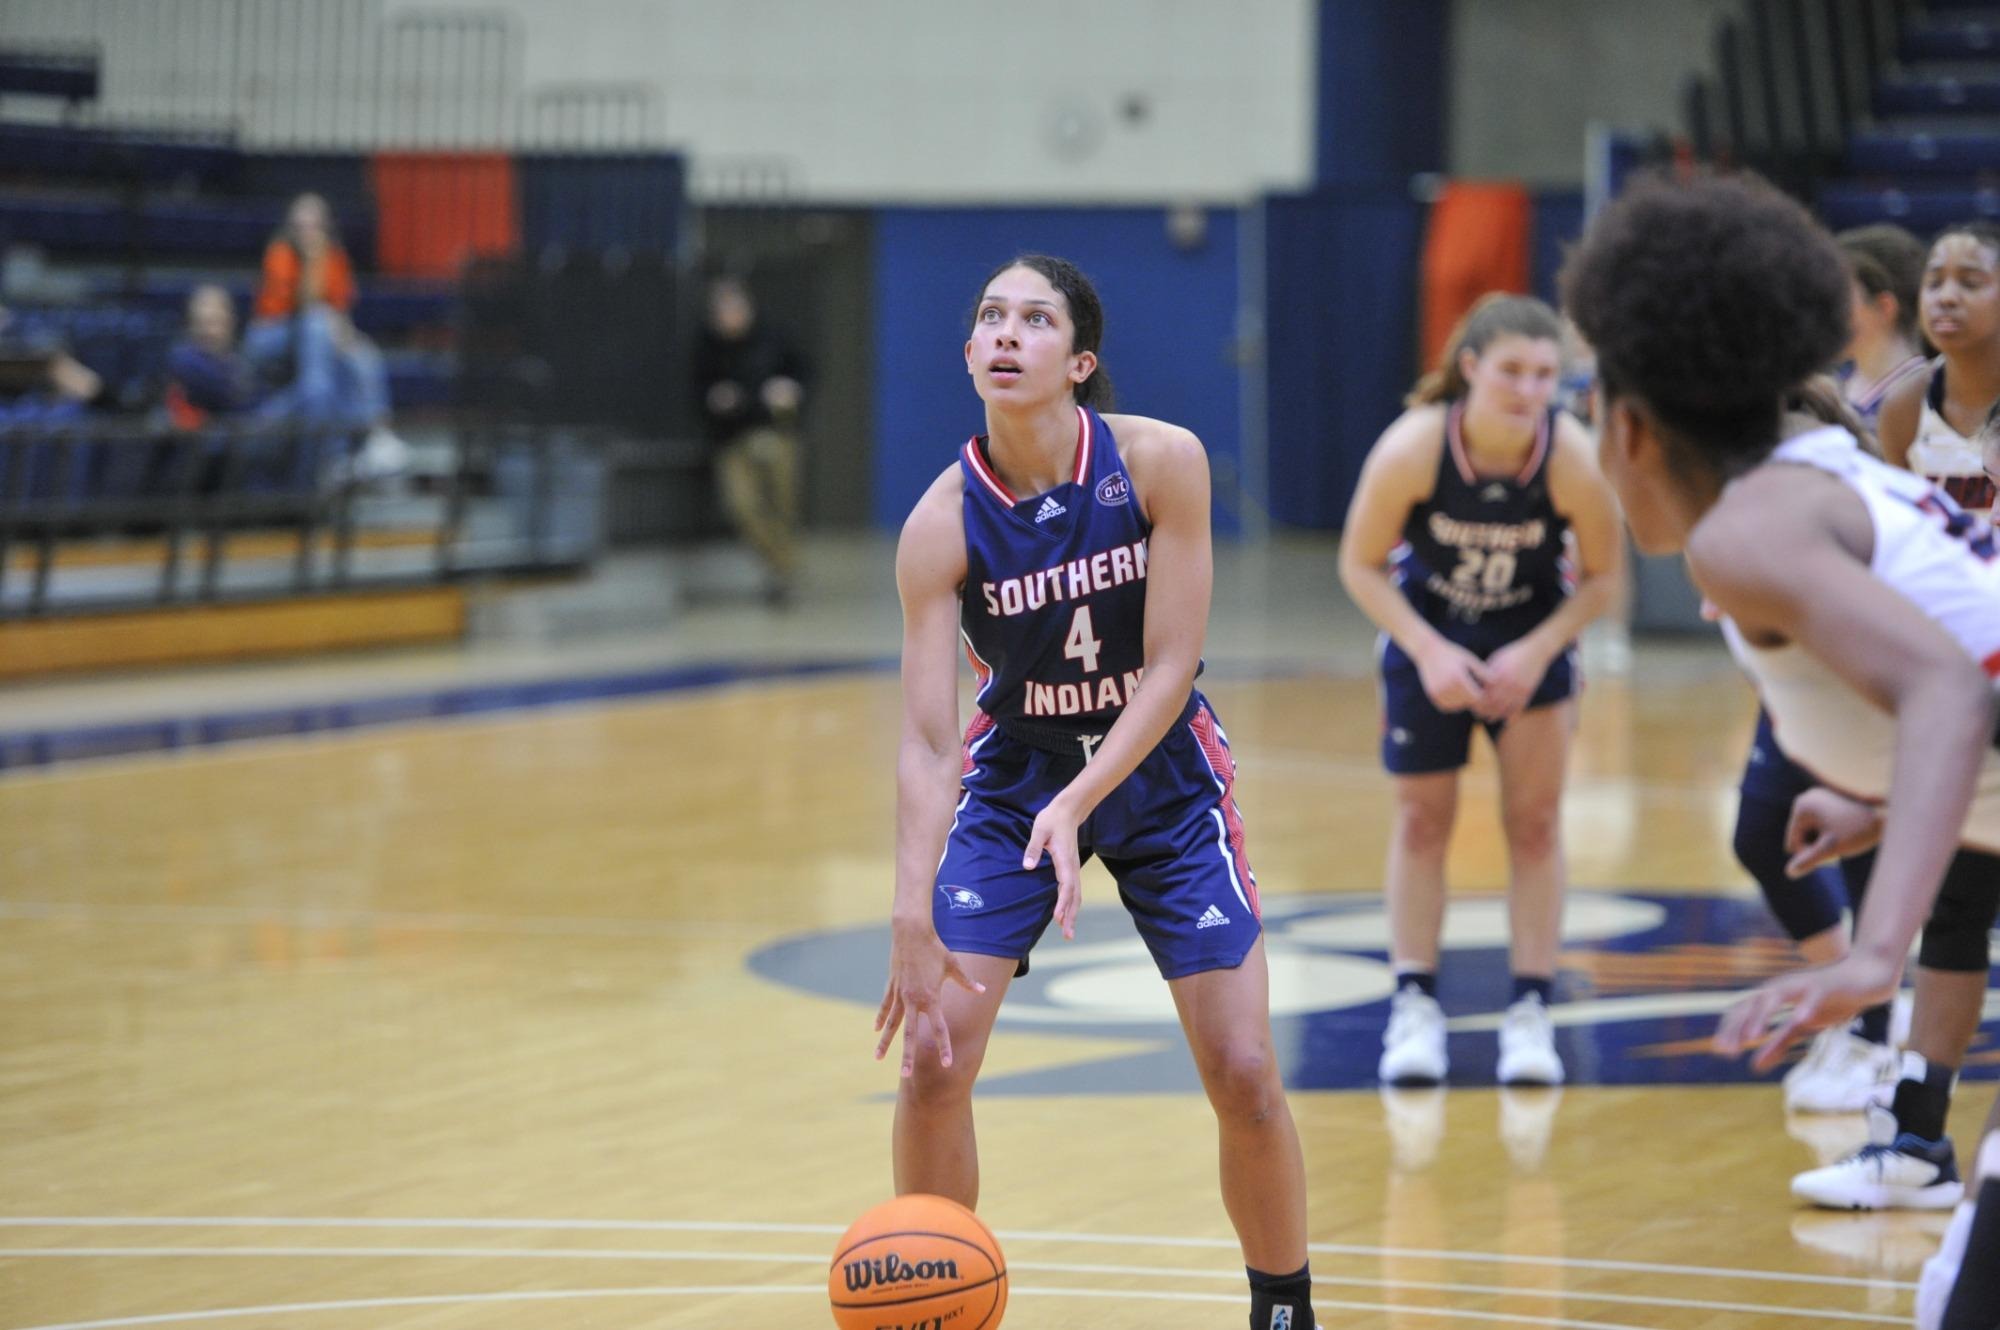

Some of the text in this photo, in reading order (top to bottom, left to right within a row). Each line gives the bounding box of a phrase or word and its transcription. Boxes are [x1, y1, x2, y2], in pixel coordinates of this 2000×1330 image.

[1034, 505, 1066, 523] adidas
[982, 537, 1148, 617] SOUTHERN
[1452, 549, 1517, 595] 20
[1063, 604, 1102, 673] 4
[1024, 667, 1144, 716] INDIAN
[1196, 917, 1230, 929] adidas
[844, 1253, 958, 1292] Wilson
